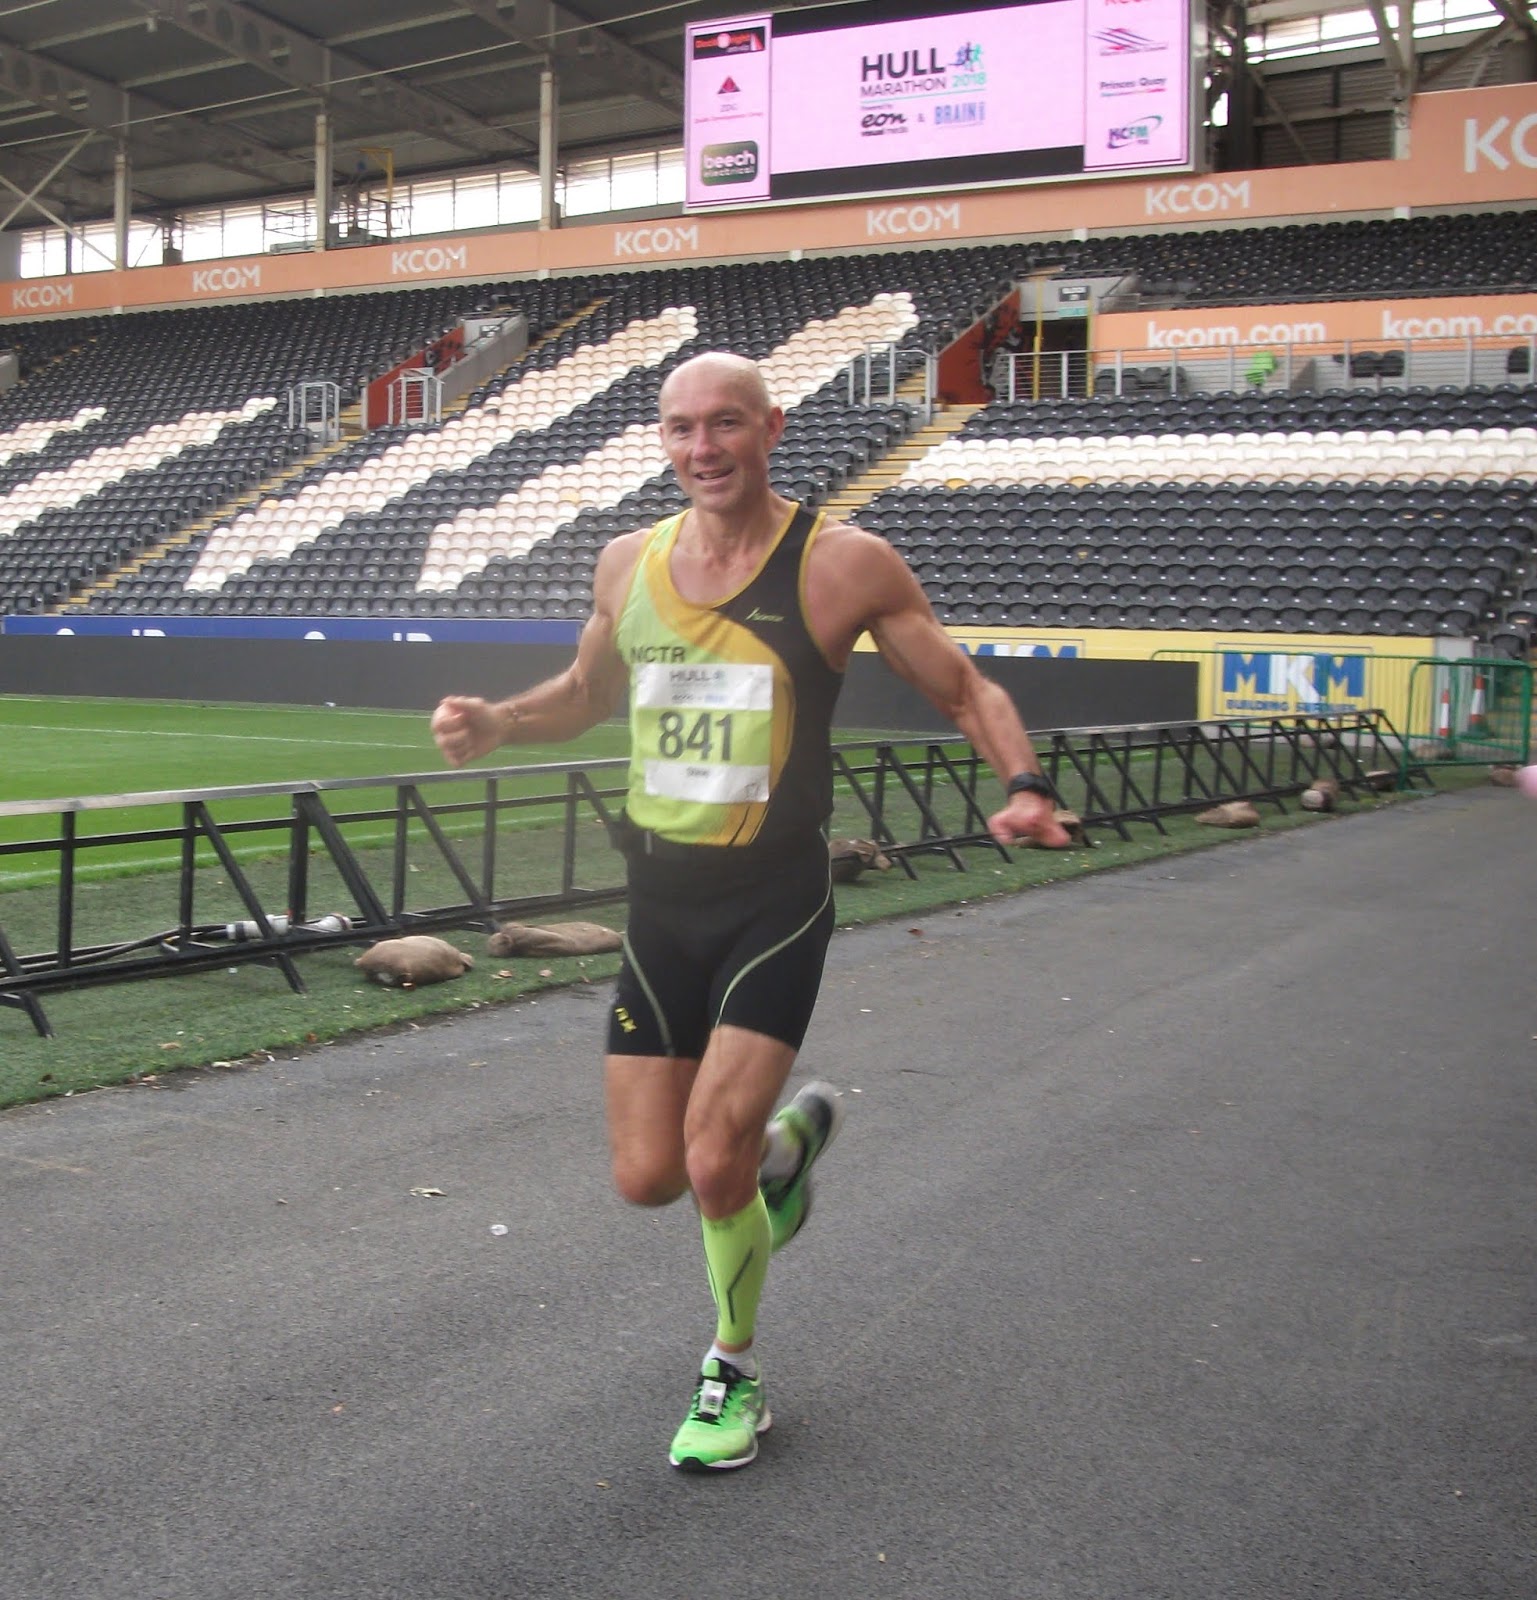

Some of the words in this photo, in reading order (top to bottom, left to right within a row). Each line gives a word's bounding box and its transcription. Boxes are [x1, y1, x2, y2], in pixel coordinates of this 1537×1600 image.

[861, 48, 946, 82] HULL
[860, 77, 947, 97] MARATHON
[952, 72, 986, 88] 2018
[703, 150, 756, 169] beech
[1144, 180, 1251, 215] KCOM
[866, 202, 961, 236] KCOM
[614, 225, 699, 256] KCOM
[391, 246, 467, 275] KCOM
[192, 265, 261, 293] KCOM
[12, 283, 74, 310] KCOM
[1147, 320, 1326, 350] kcom.com
[630, 646, 685, 663] NCTR
[1222, 653, 1365, 703] MKM
[658, 711, 733, 761] 841
